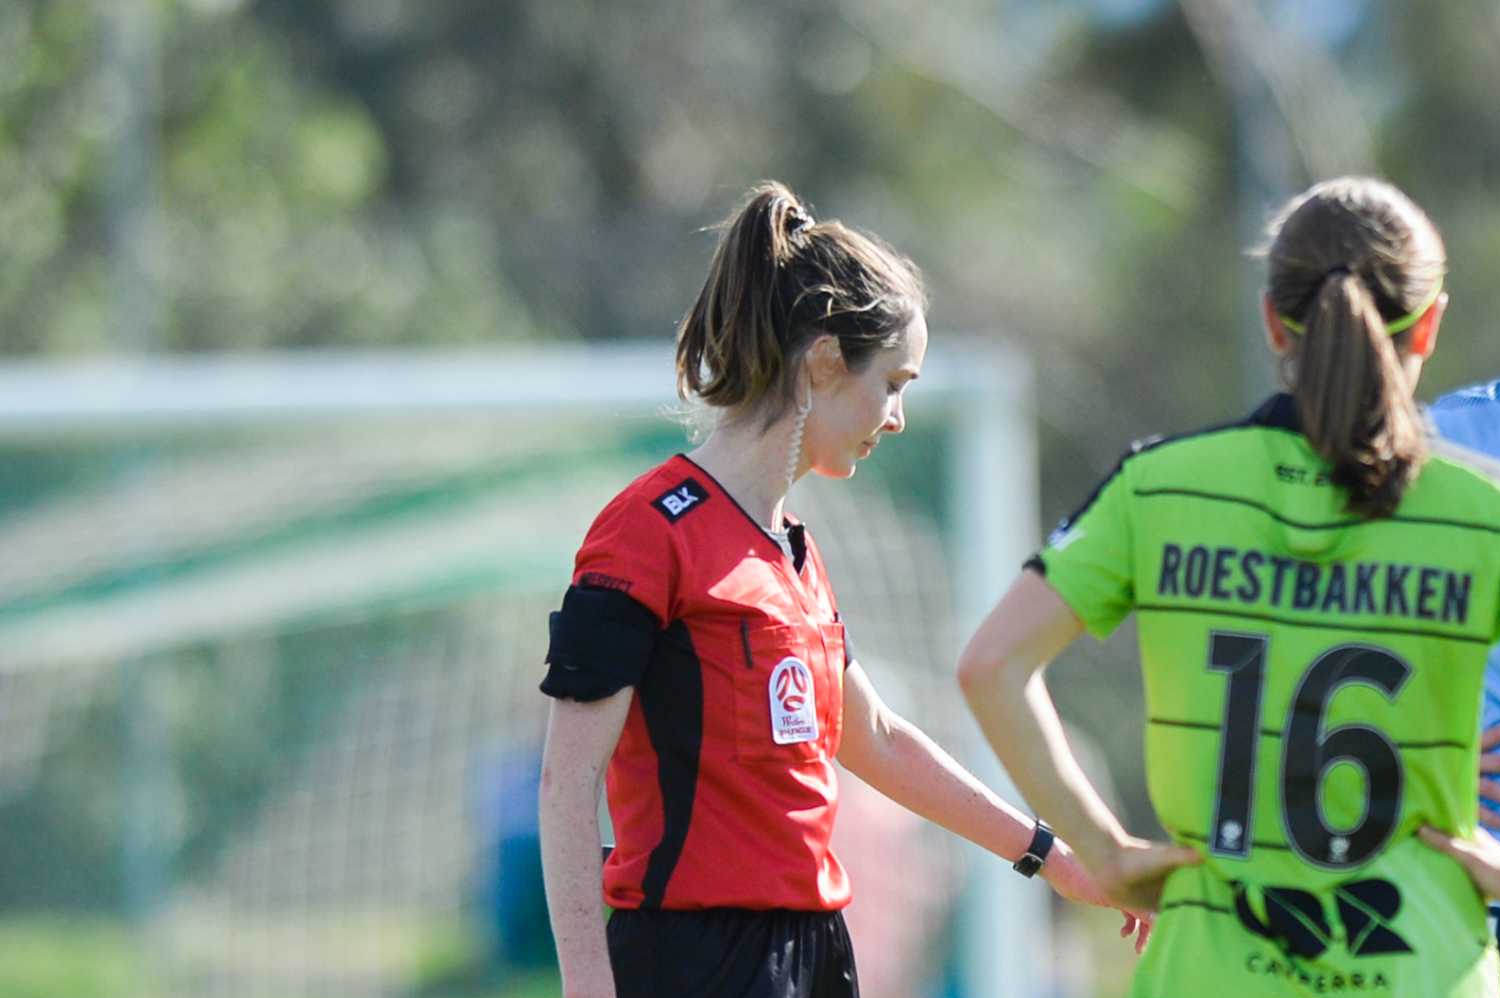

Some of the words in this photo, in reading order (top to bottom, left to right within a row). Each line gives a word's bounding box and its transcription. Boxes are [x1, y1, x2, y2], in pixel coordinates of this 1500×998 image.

[662, 486, 699, 516] BLK
[1157, 543, 1473, 625] ROESTBAKKEN
[1206, 628, 1414, 872] 16
